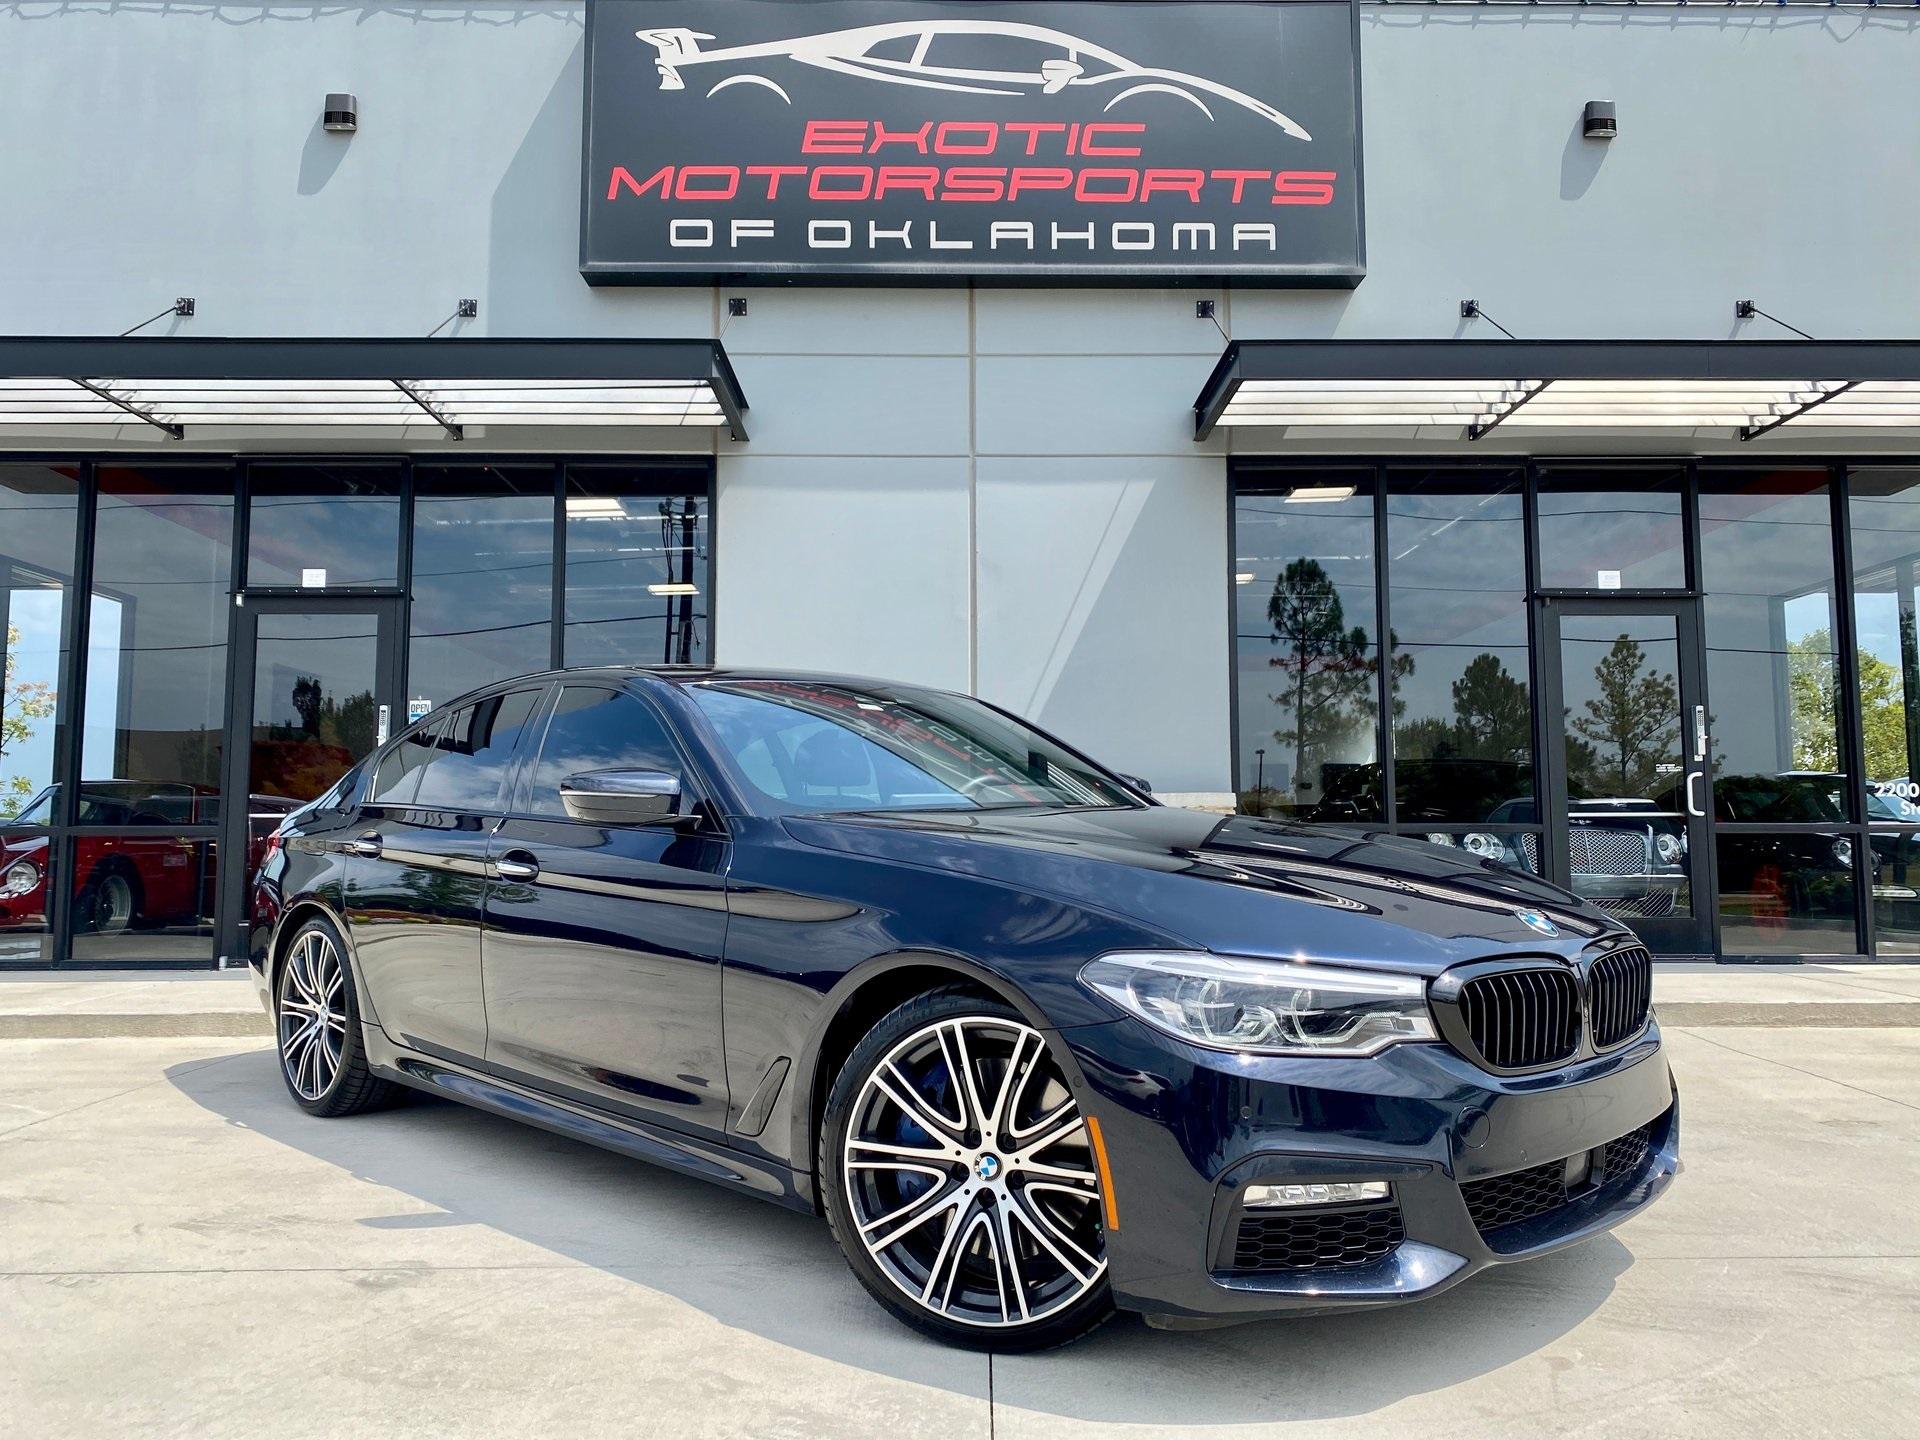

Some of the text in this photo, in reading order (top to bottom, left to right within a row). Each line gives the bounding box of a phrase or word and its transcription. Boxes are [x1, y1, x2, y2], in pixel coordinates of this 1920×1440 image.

[801, 120, 1146, 157] EXOTIC
[607, 165, 1337, 205] MOTORSPORTS
[669, 219, 1276, 251] OF OKLAHOMA
[410, 703, 430, 713] OPEN
[1874, 782, 1920, 798] 2200
